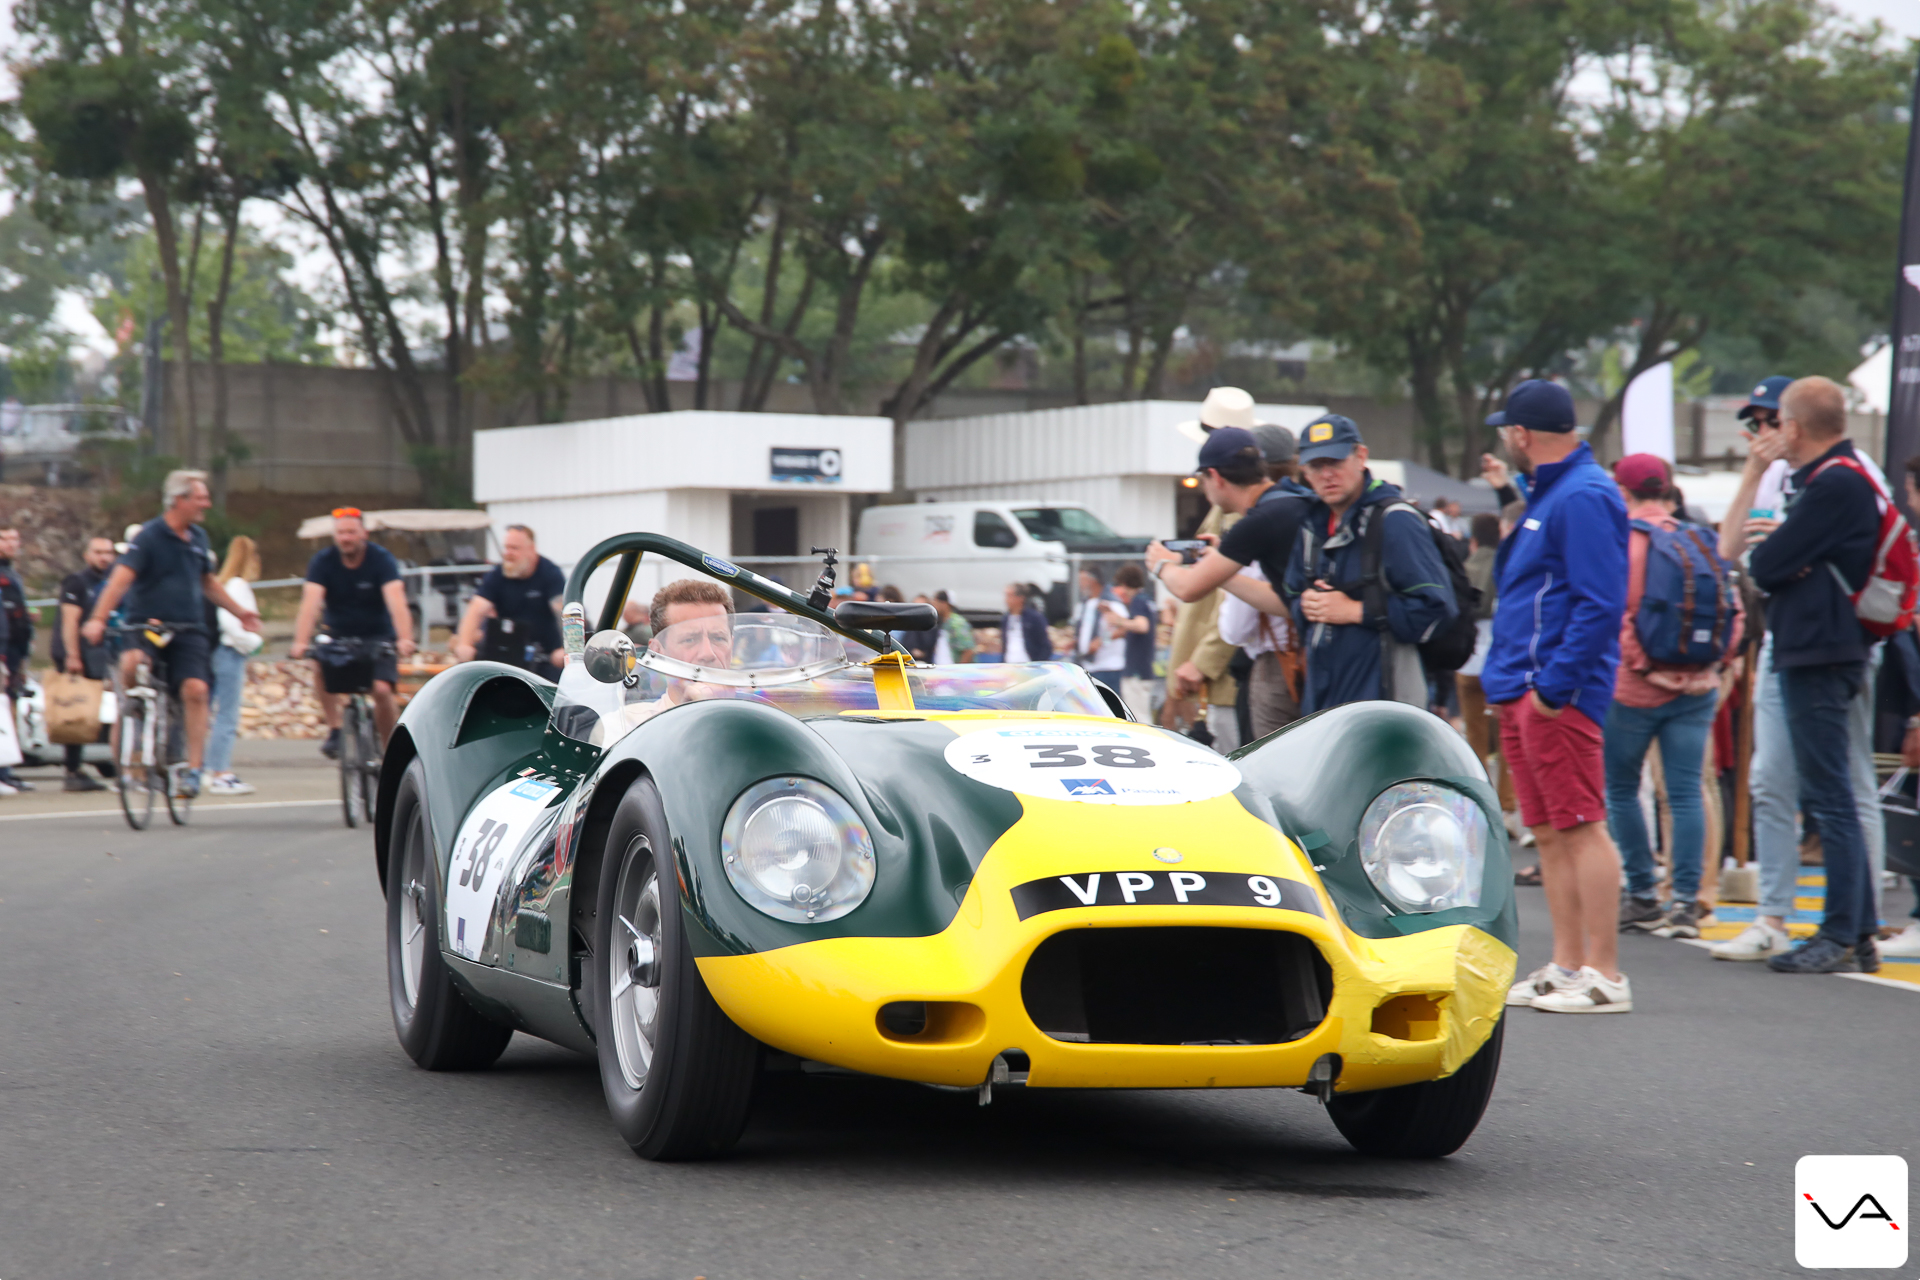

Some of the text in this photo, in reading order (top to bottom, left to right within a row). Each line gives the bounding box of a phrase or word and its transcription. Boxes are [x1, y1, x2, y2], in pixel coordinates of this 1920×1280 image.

[1009, 730, 1119, 738] aramco
[1023, 744, 1157, 769] 38
[459, 818, 509, 893] 38
[1059, 871, 1282, 907] VPP 9
